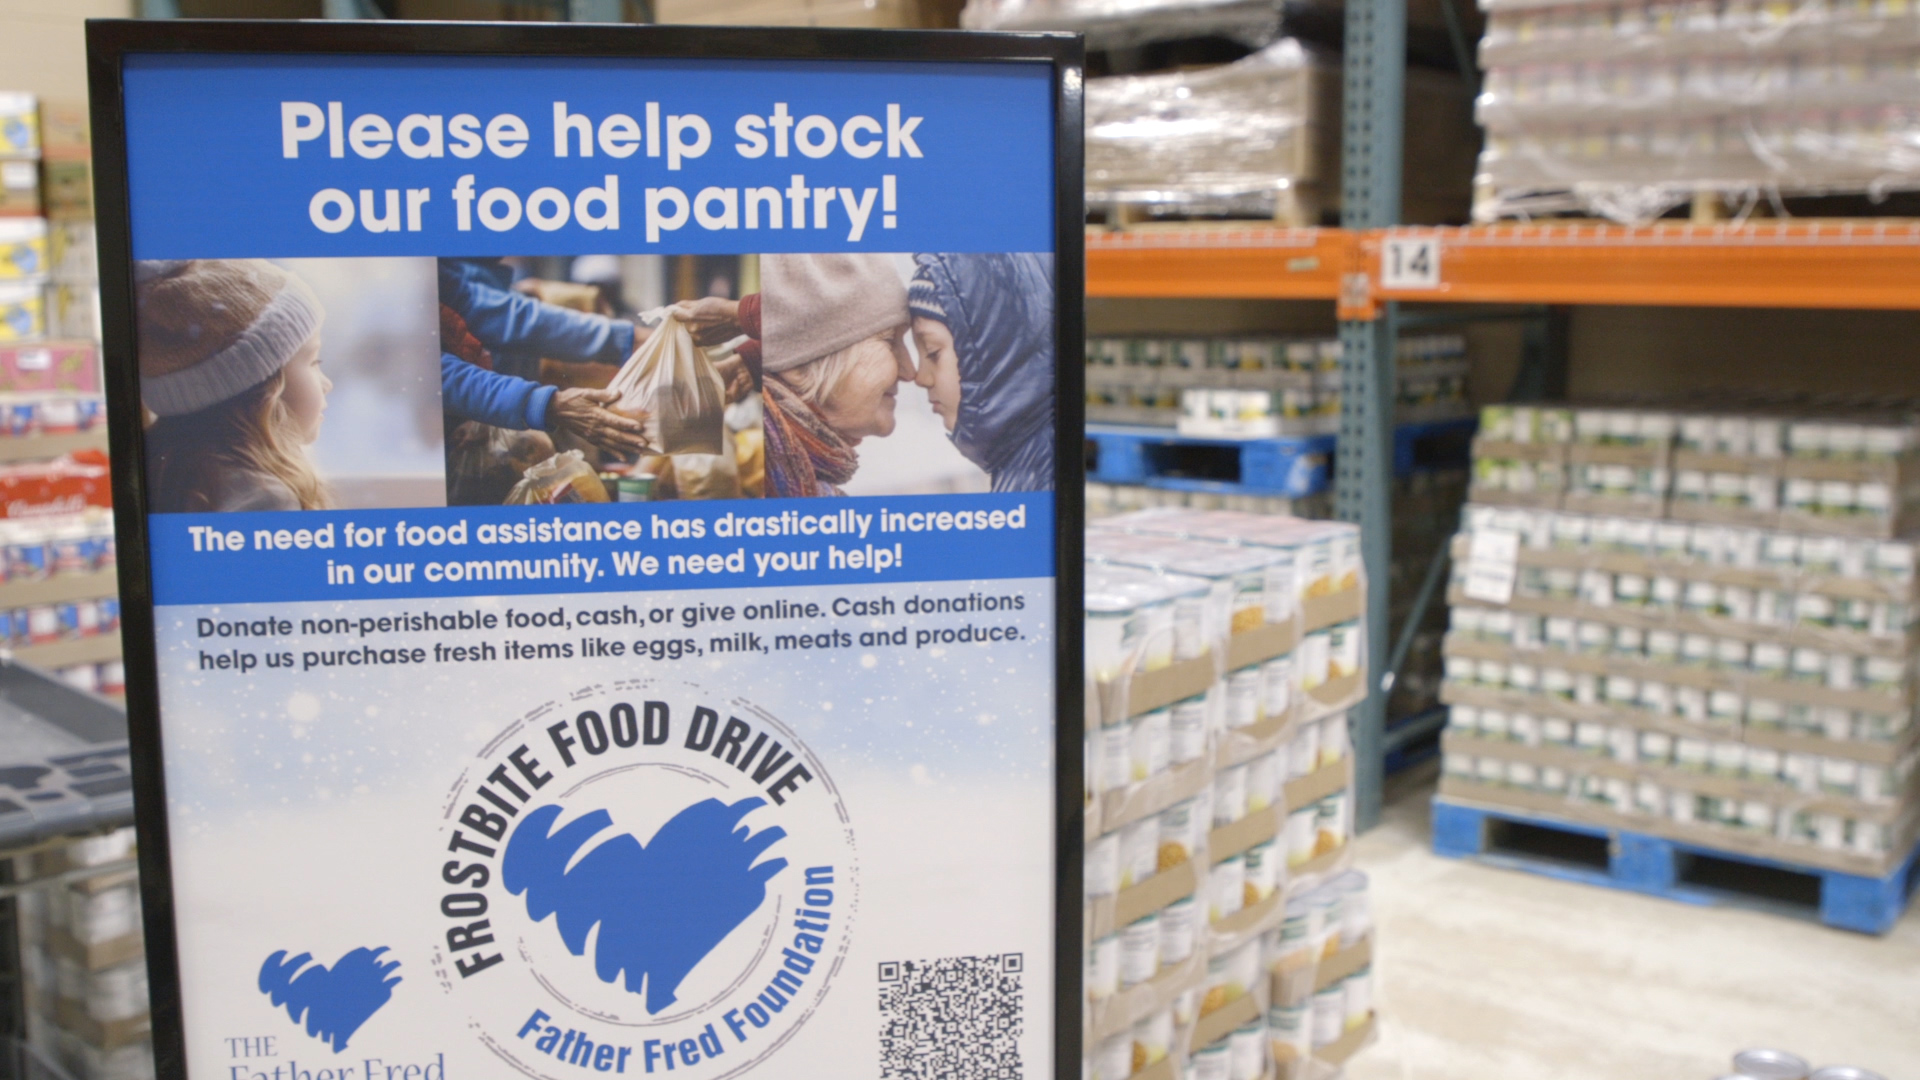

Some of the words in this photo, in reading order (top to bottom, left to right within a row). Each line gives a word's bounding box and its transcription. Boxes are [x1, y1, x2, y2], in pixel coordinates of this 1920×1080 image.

[280, 101, 531, 160] Please
[552, 101, 713, 171] help
[734, 102, 925, 160] stock
[308, 186, 432, 234] our
[451, 174, 621, 233] food
[644, 173, 898, 244] pantry!
[1390, 243, 1430, 278] 14
[187, 525, 247, 552] The
[253, 522, 336, 550] need
[343, 521, 387, 548] for
[395, 519, 468, 547] food
[476, 516, 643, 545] assistance
[651, 514, 707, 540] has
[713, 508, 874, 539] drastically
[880, 503, 1027, 533] increased
[326, 559, 356, 585] in
[363, 562, 416, 584] our
[423, 552, 605, 583] community.
[611, 550, 660, 577] We
[667, 547, 746, 576] need
[753, 549, 821, 578] your
[828, 542, 904, 574] help!
[196, 615, 294, 638] Donate
[301, 608, 498, 638] non-perishable
[505, 607, 572, 630] food,
[575, 604, 645, 628] cash,
[648, 607, 675, 624] or
[681, 602, 736, 629] give
[742, 600, 826, 622] online.
[831, 597, 896, 618] Cash
[903, 592, 1026, 616] donations
[198, 649, 258, 674] help
[265, 651, 295, 669] us
[302, 646, 427, 673] purchase
[433, 642, 497, 664] fresh
[504, 640, 575, 661] items
[581, 636, 626, 659] like
[632, 640, 704, 662] eggs,
[709, 631, 770, 654] milk,
[774, 633, 853, 652] meats
[858, 626, 908, 649] and
[915, 626, 1027, 651] produce.
[440, 743, 554, 979] FROSTBITE
[546, 700, 670, 769] FOOD
[684, 705, 814, 807] DRIVE
[516, 1008, 632, 1074] Father
[643, 1022, 725, 1074] Fred
[721, 865, 834, 1044] Foundation
[224, 1035, 278, 1059] THE
[362, 1052, 445, 1080] Fred
